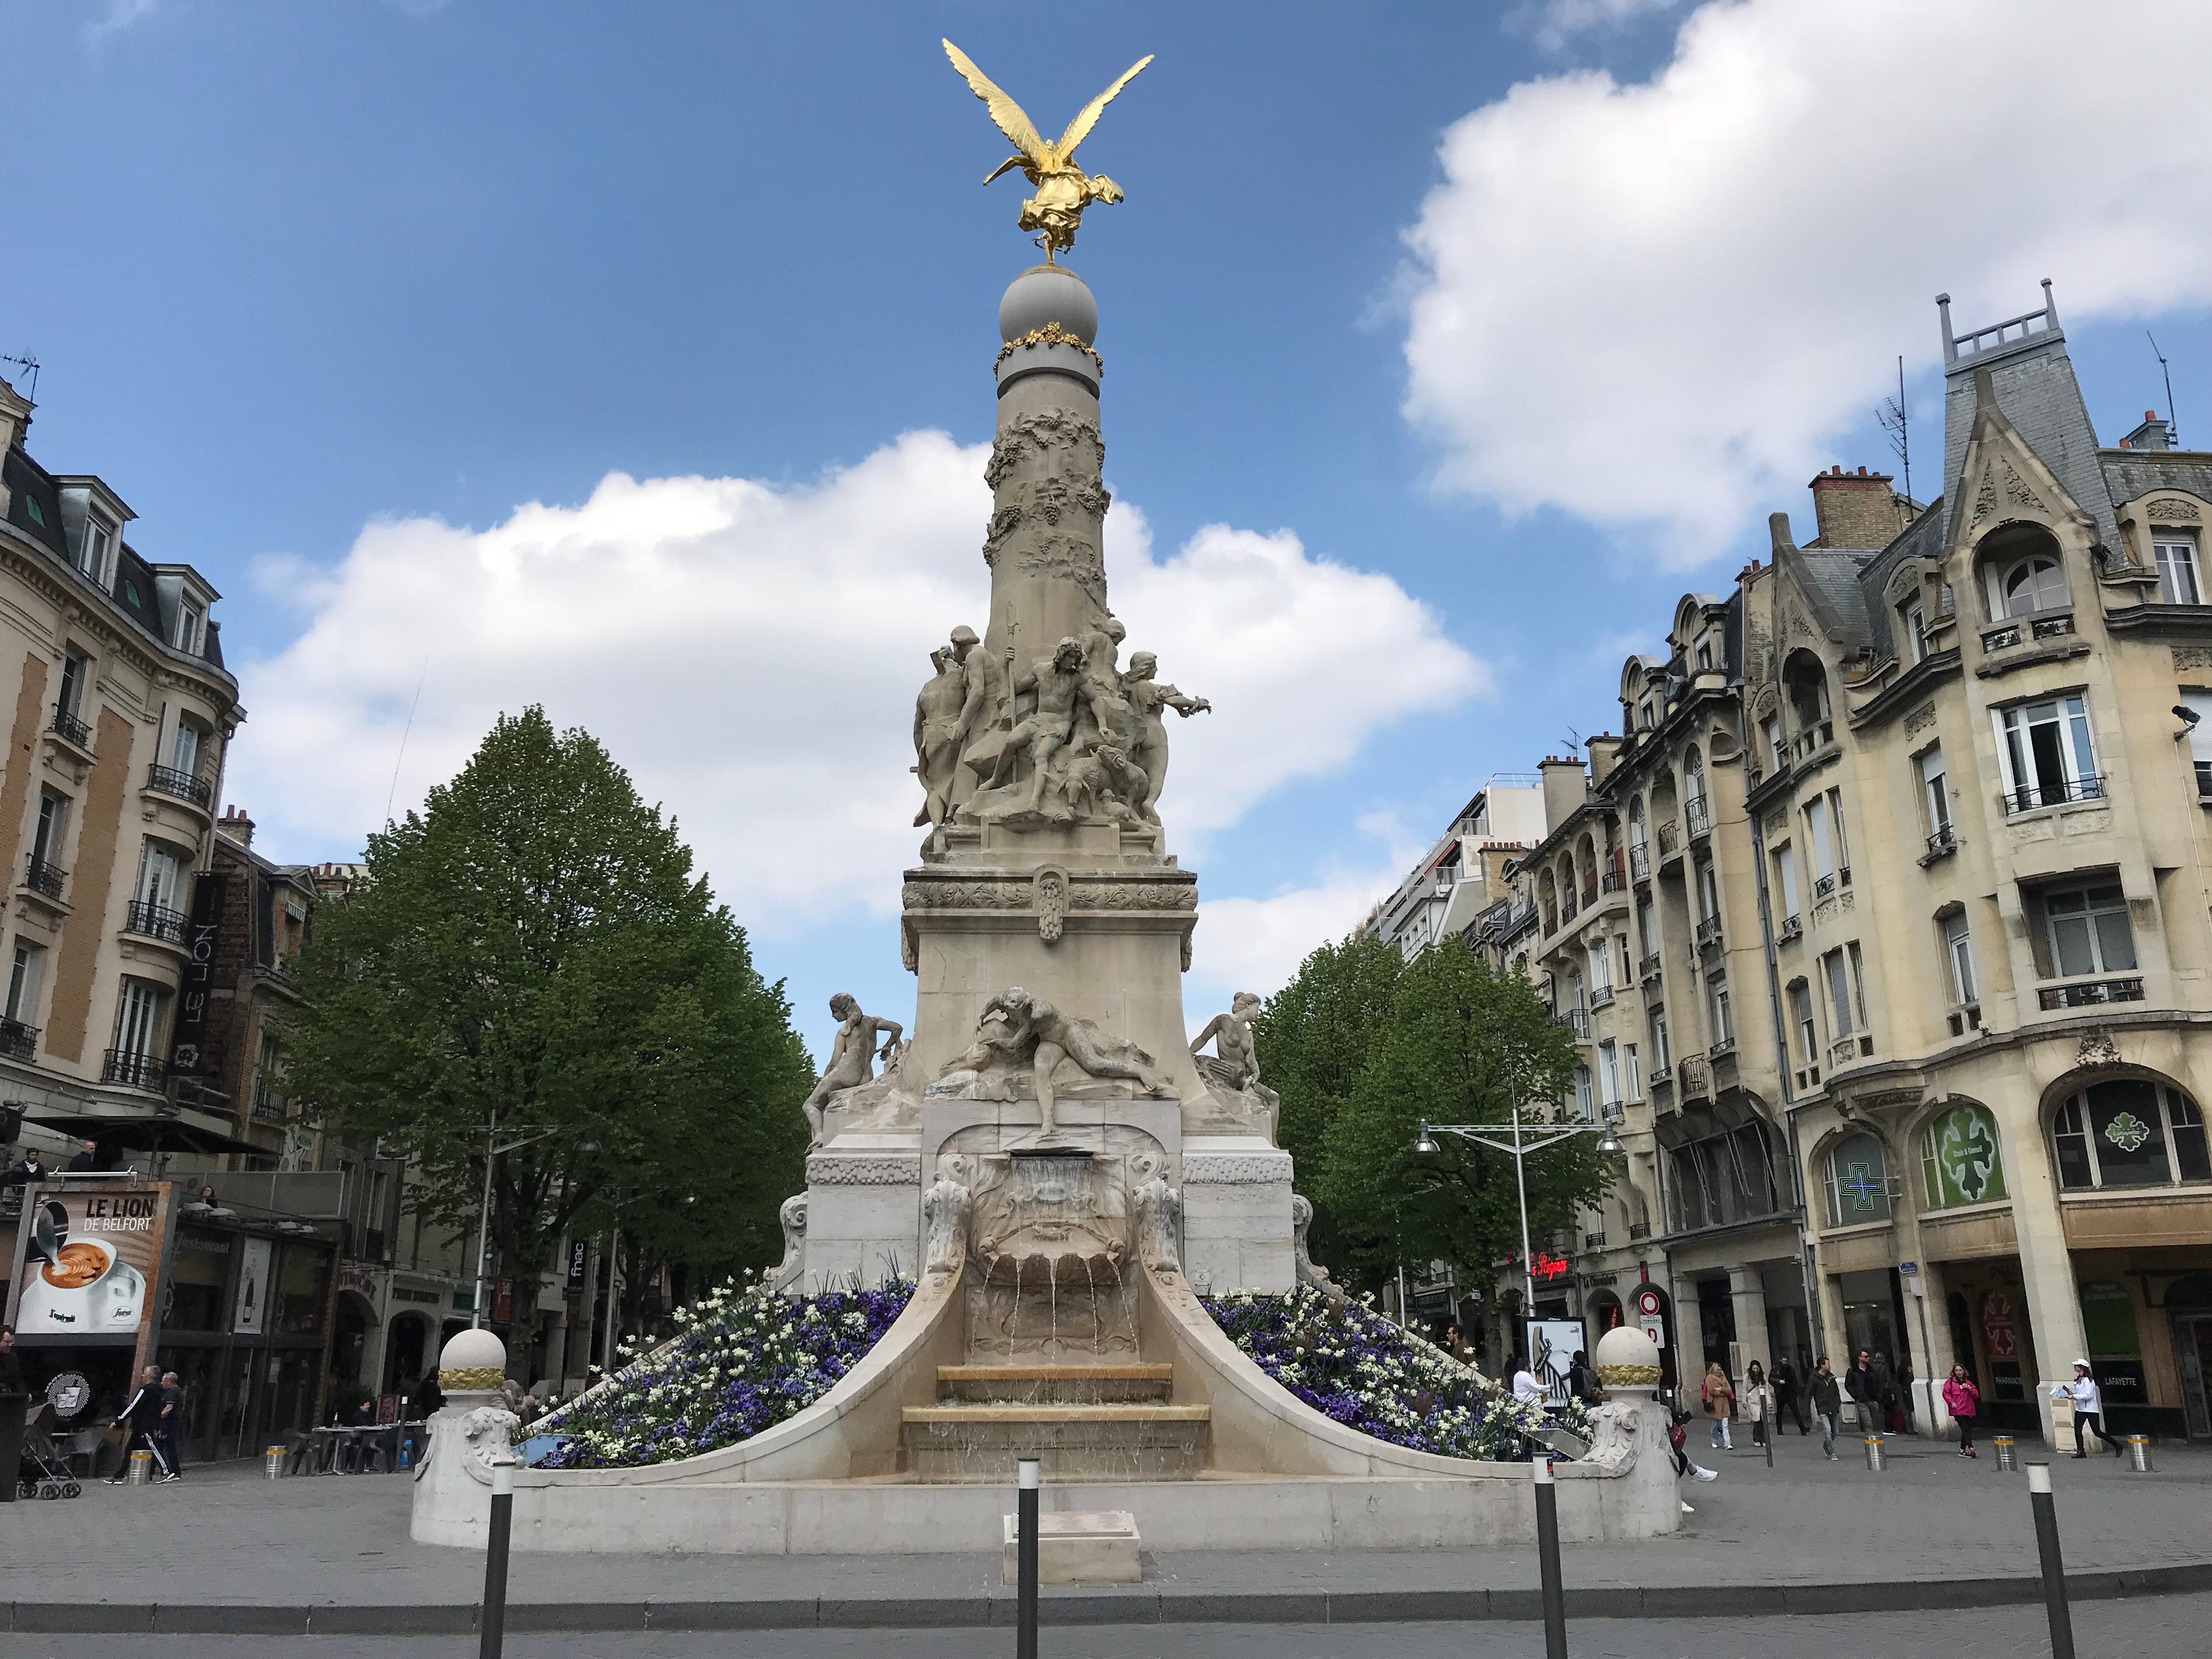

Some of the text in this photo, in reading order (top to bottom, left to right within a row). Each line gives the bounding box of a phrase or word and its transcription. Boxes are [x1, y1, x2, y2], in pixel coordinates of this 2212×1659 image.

[185, 924, 218, 1023] LE LION
[86, 1198, 155, 1217] LE LION
[84, 1217, 152, 1231] DE BELFORT
[571, 1243, 584, 1277] fnac
[2104, 1377, 2137, 1386] LAFAYETTE
